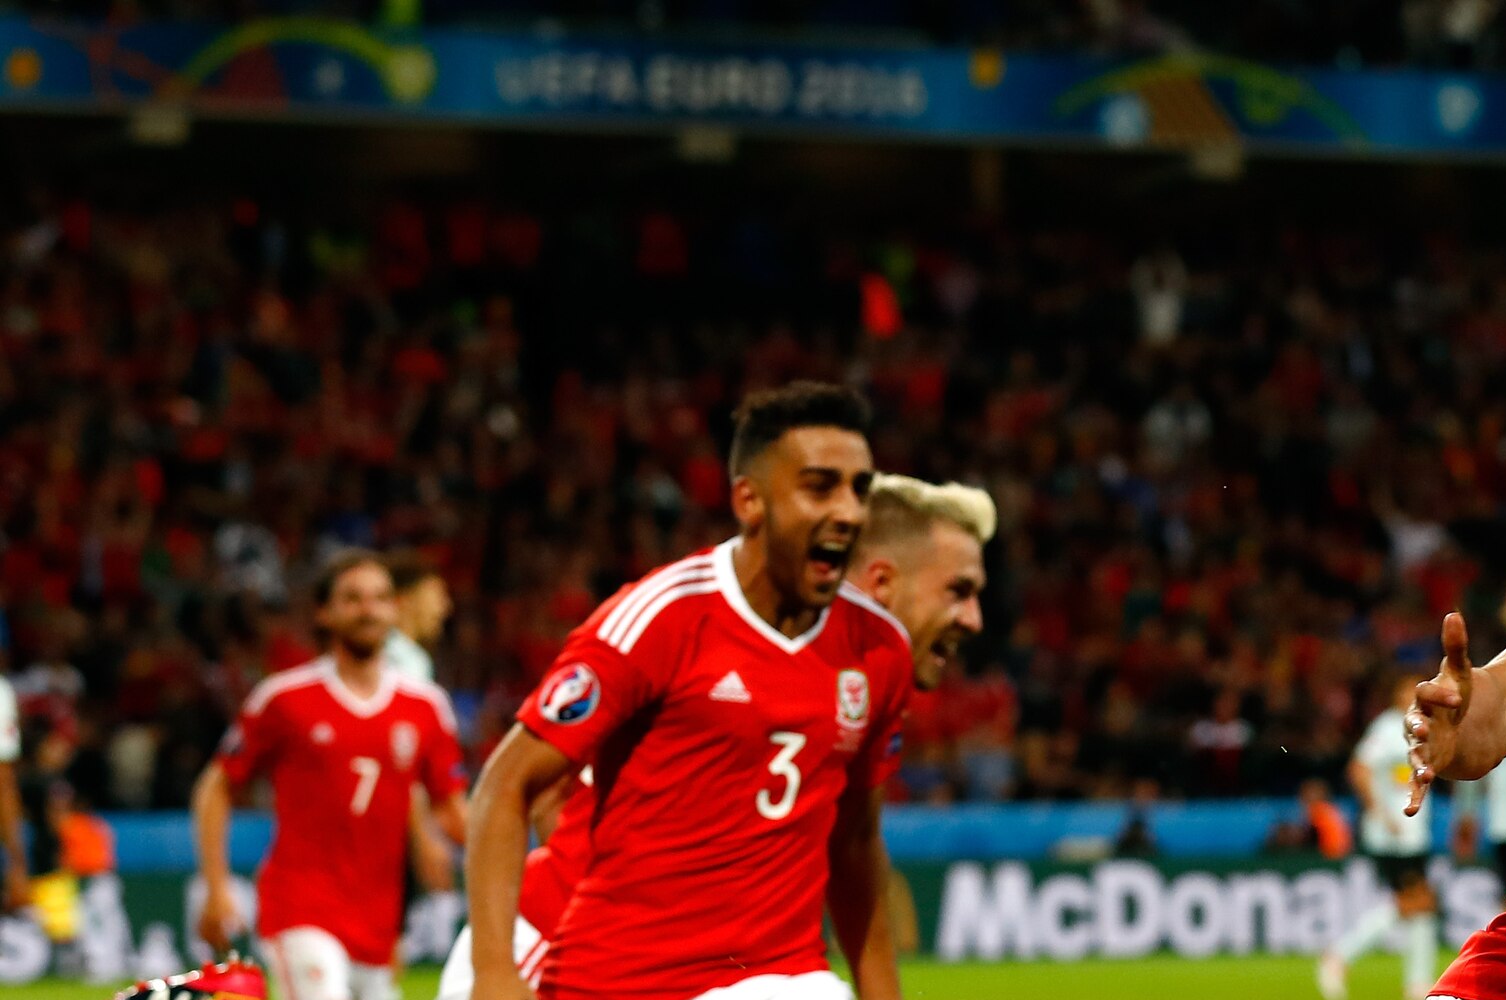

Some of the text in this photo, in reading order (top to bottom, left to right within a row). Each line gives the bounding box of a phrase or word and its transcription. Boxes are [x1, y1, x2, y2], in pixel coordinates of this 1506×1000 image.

[349, 755, 382, 817] 7
[755, 731, 807, 821] 3
[936, 857, 1505, 963] McDonal's
